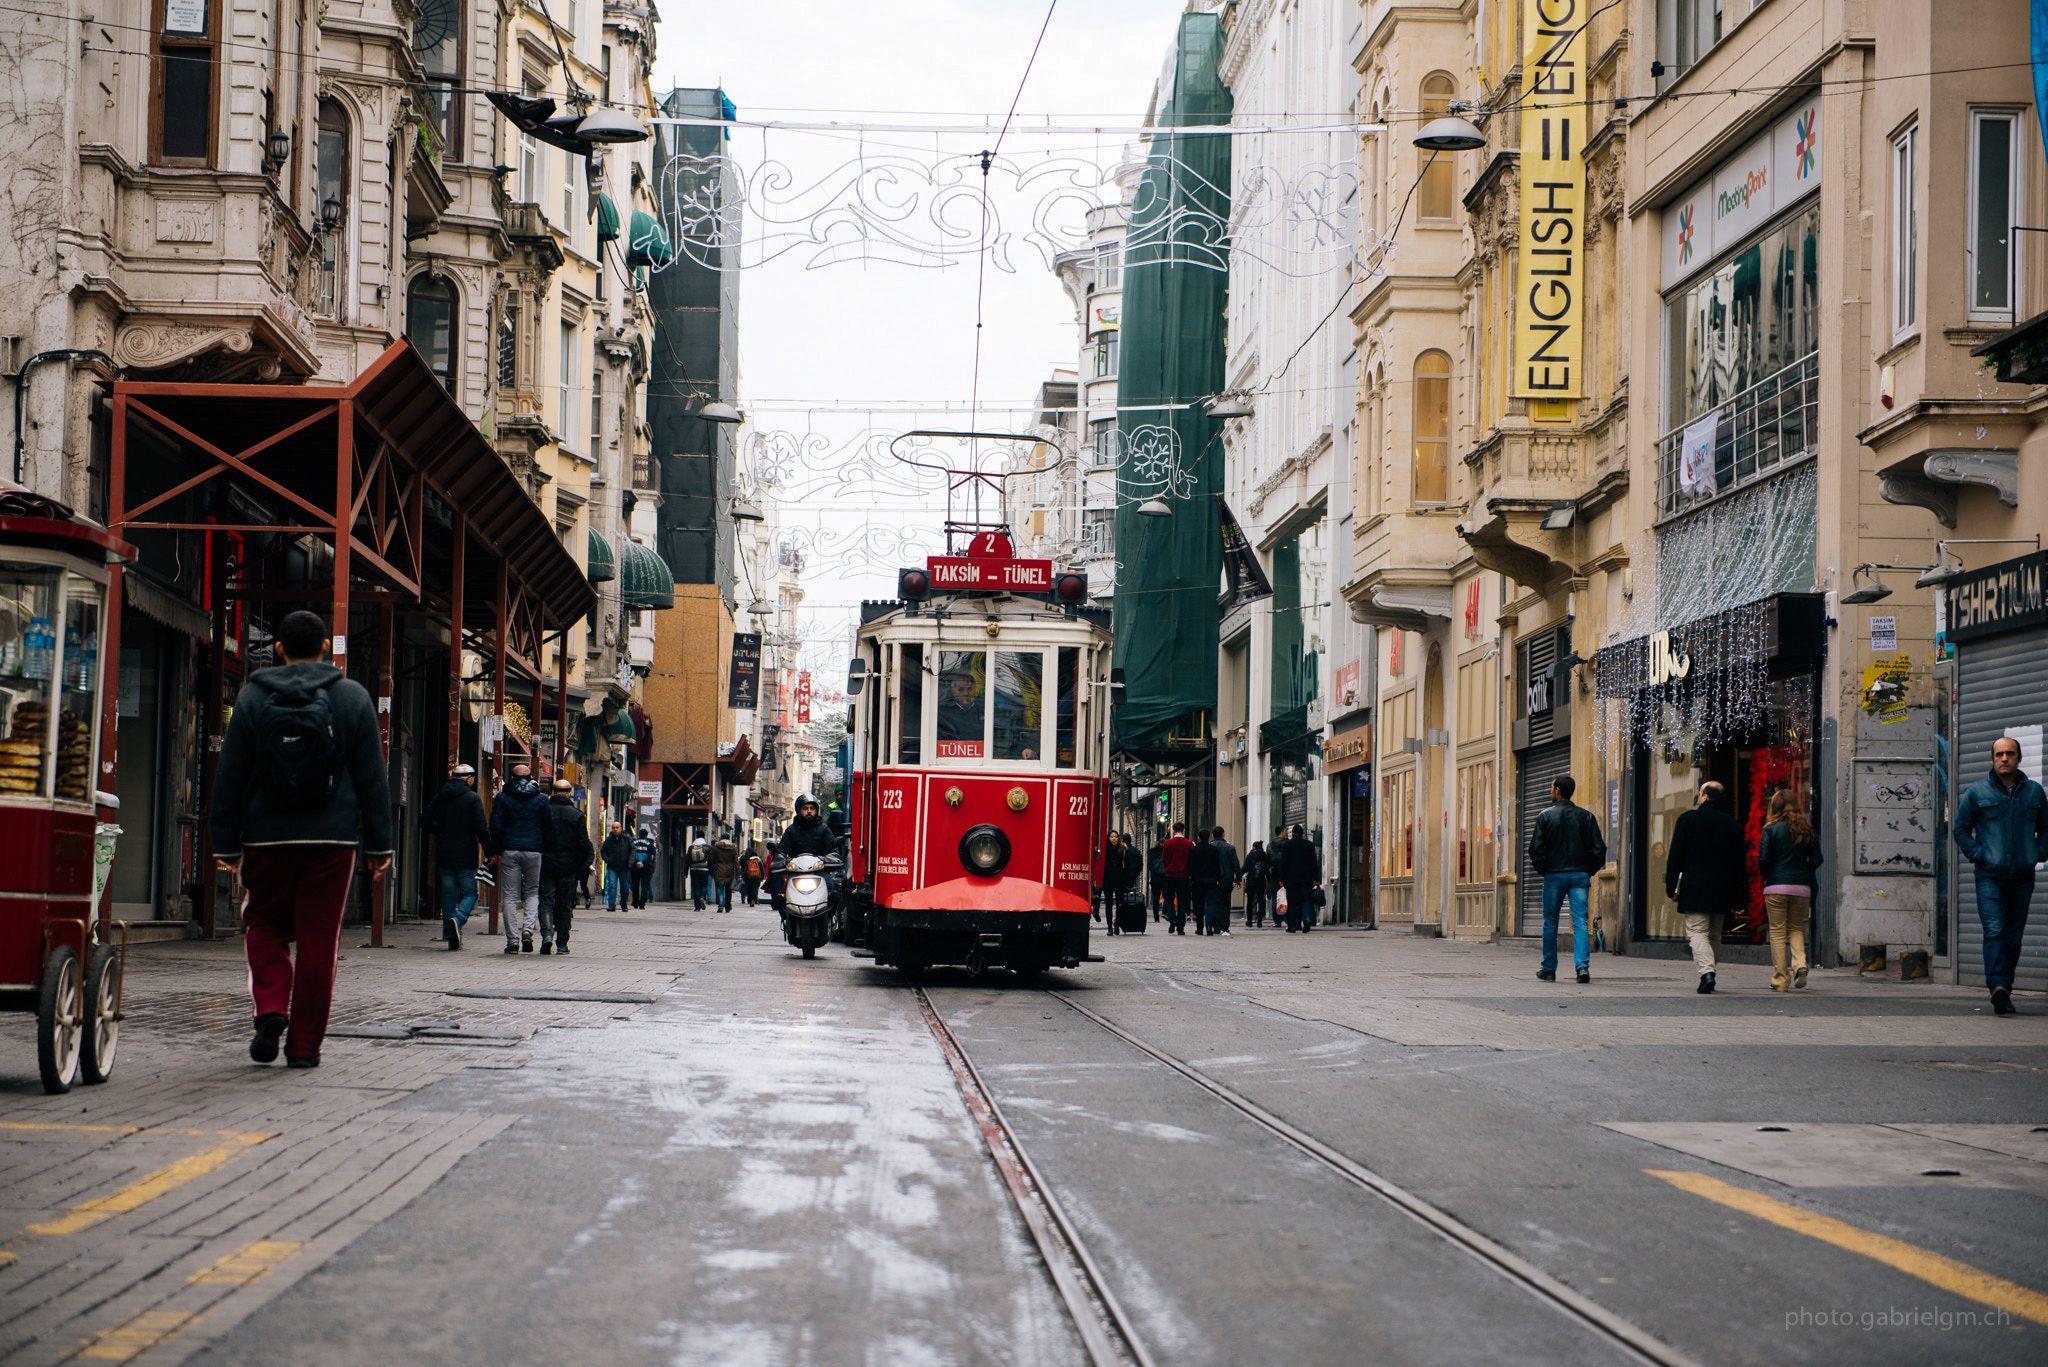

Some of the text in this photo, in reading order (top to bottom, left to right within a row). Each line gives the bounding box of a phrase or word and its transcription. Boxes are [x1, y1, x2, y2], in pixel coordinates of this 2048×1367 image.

[1528, 182, 1574, 390] ENGLISH
[985, 533, 994, 552] 2
[1003, 564, 1047, 584] TÜNEL
[940, 743, 981, 756] TÜNEL
[883, 790, 902, 809] 223
[1069, 796, 1088, 816] 223
